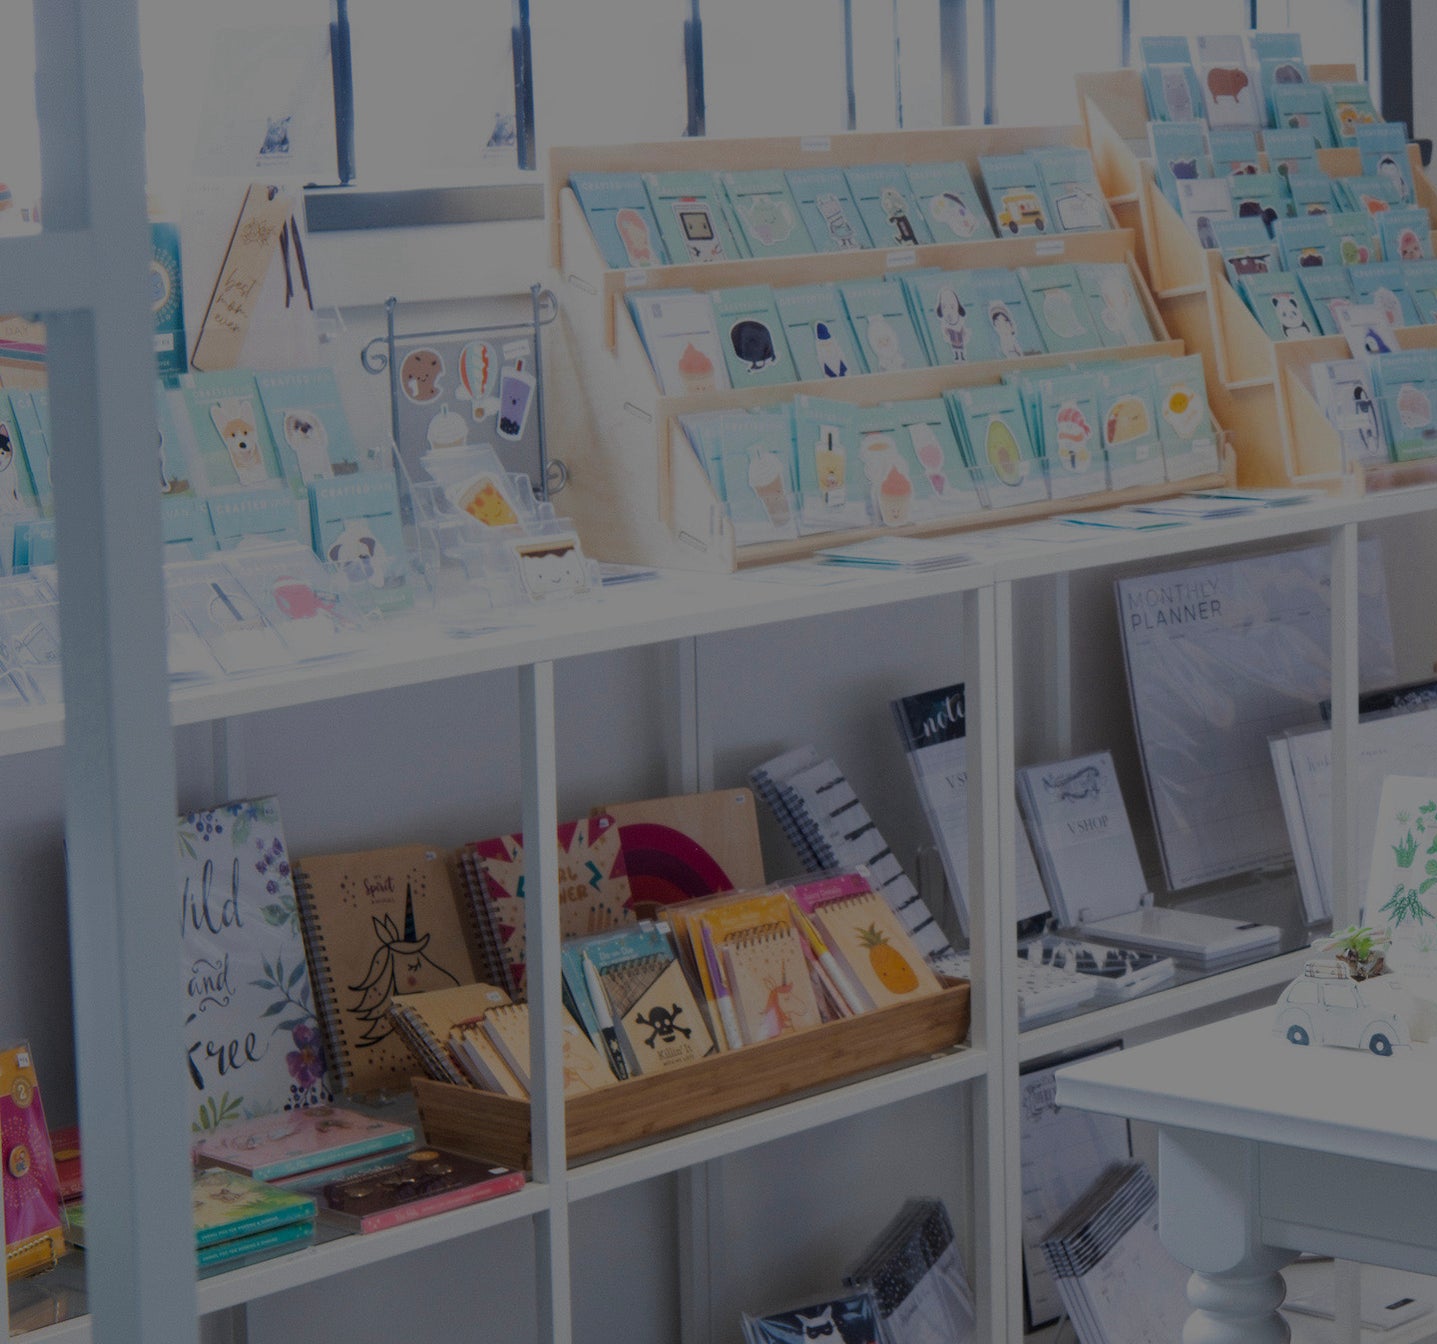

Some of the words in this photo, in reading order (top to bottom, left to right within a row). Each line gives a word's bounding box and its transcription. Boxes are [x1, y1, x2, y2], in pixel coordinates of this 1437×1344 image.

[217, 500, 268, 513] CRAFTED
[321, 483, 370, 498] CRAFTED
[1127, 579, 1220, 611] MONTHLY
[1129, 599, 1223, 632] PLANNER
[181, 857, 246, 940] ild
[187, 953, 237, 997] and
